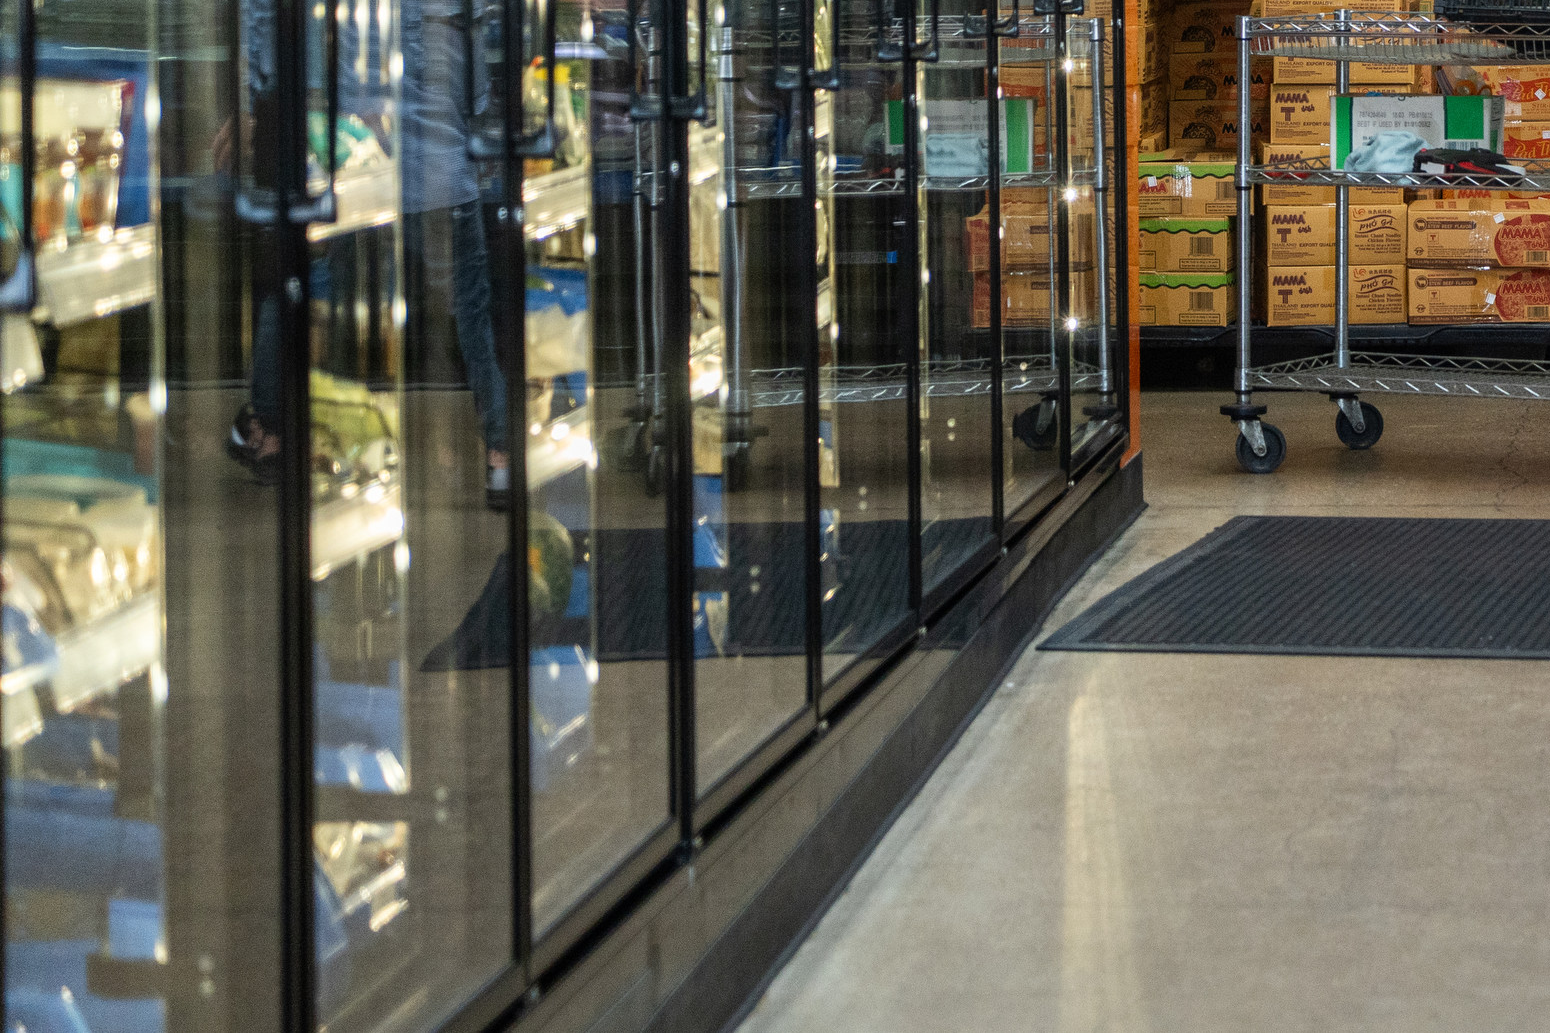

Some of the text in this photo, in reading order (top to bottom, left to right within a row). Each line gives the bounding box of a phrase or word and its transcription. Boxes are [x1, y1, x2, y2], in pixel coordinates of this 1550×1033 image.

[1275, 93, 1309, 103] MAMA
[1514, 142, 1536, 158] Pad
[1139, 182, 1167, 194] AMA
[1272, 214, 1306, 224] MAMA
[1501, 227, 1542, 239] MAMA
[1273, 275, 1307, 286] MAMA
[1502, 282, 1542, 294] MAMA
